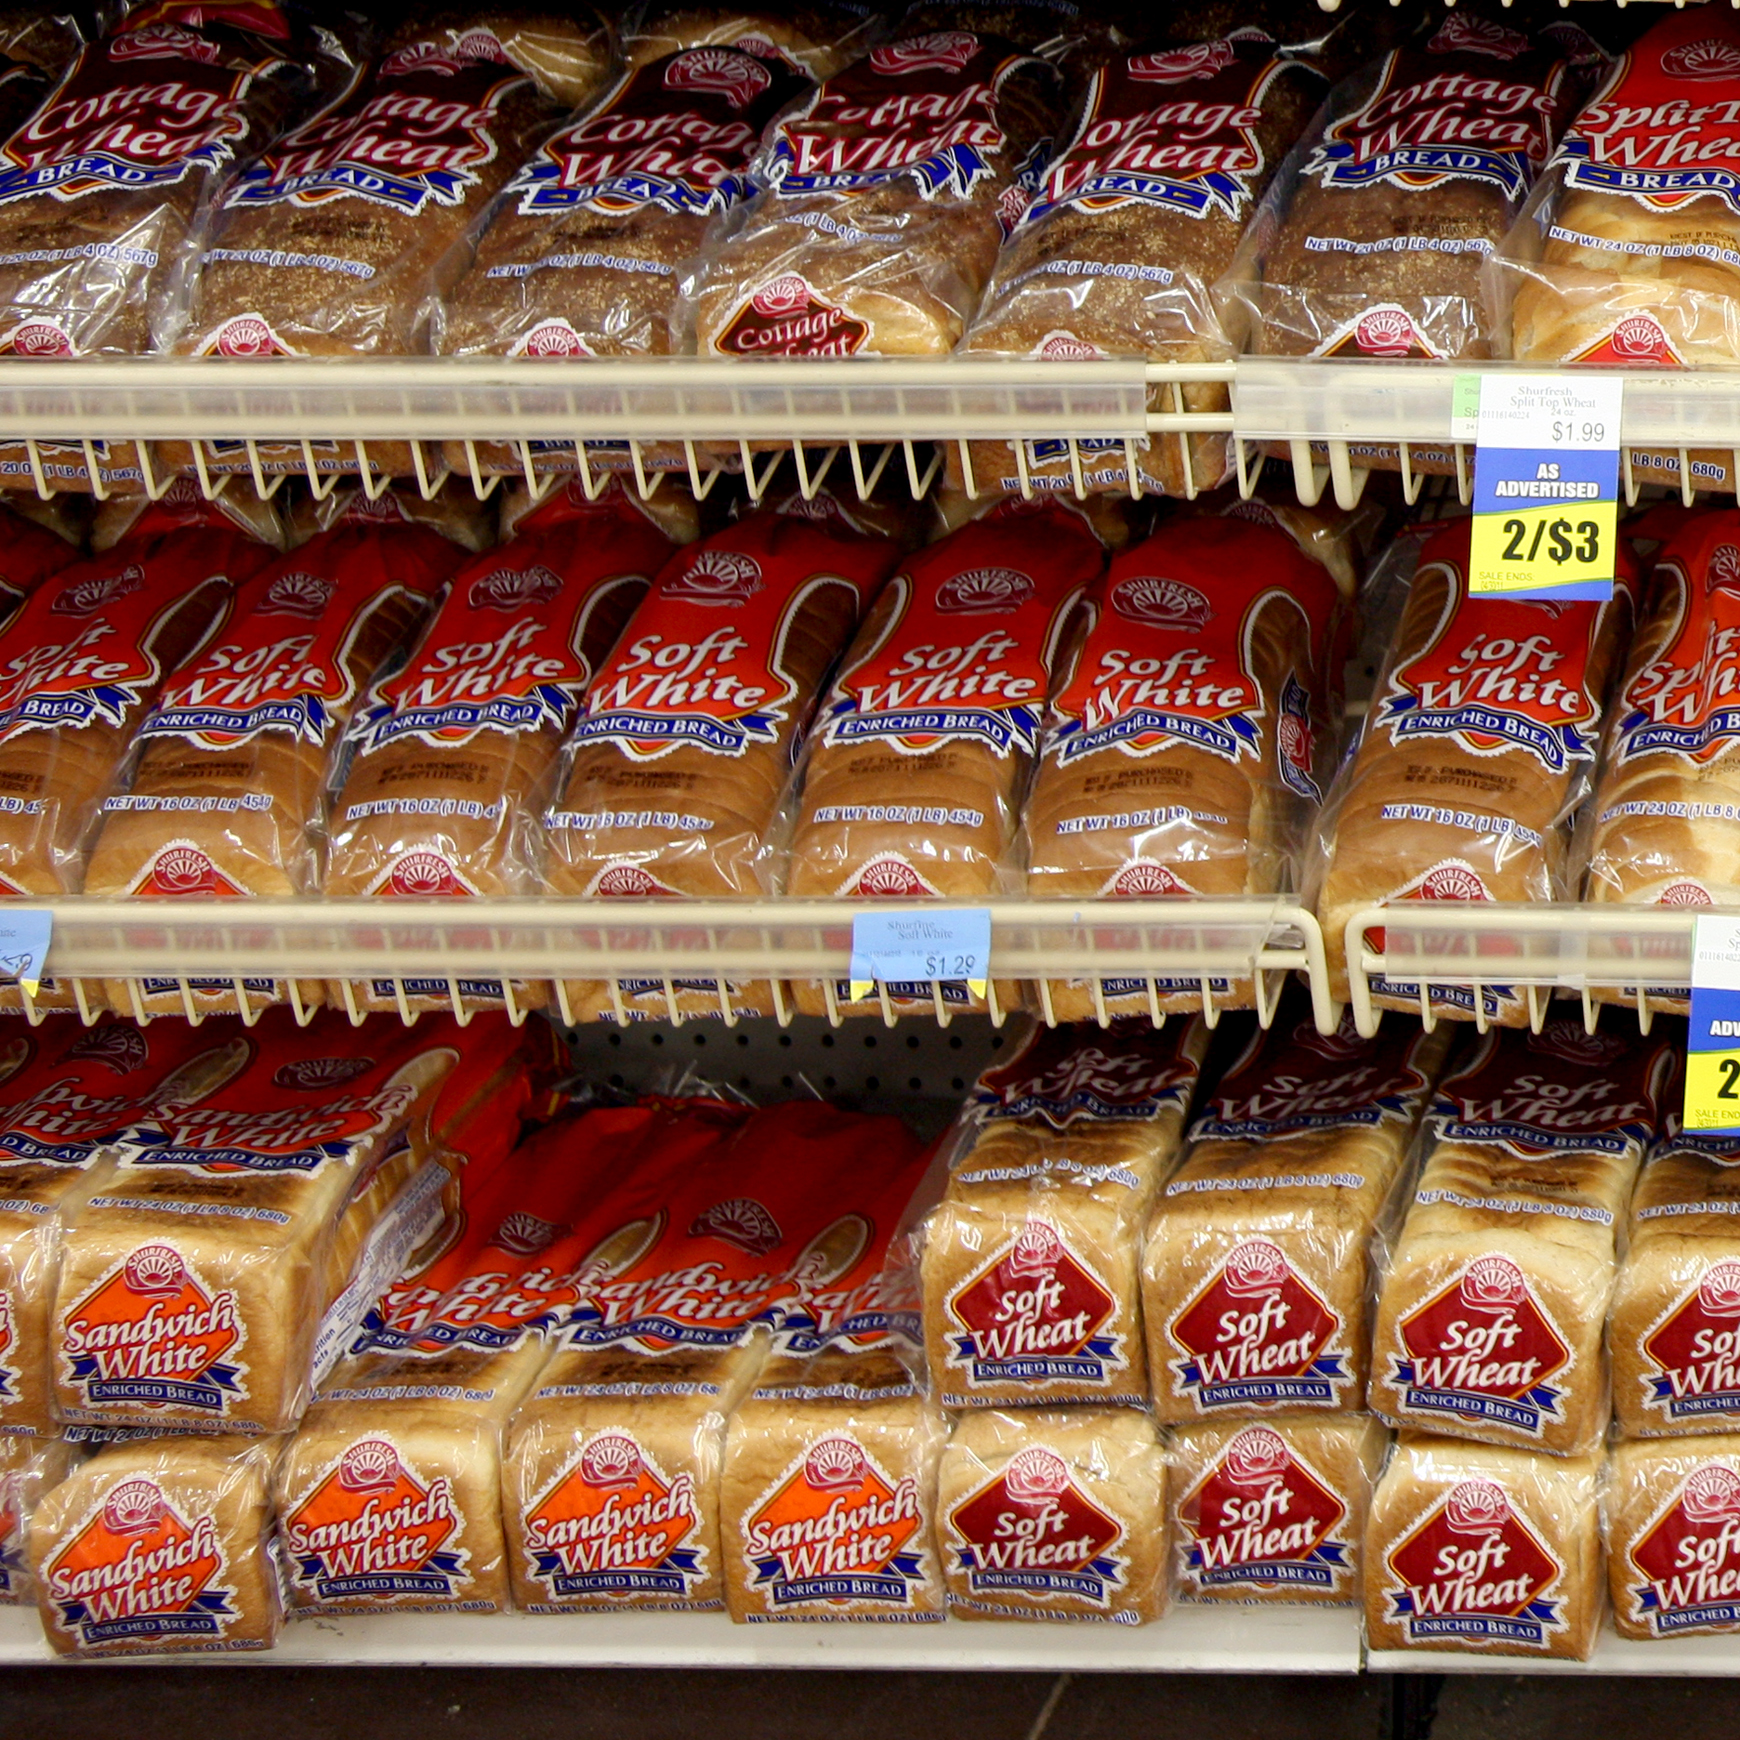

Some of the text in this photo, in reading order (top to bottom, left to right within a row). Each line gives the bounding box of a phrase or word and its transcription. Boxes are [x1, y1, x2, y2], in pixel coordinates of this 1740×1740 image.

[1359, 74, 1557, 128] Cottage
[1361, 102, 1545, 162] Wheat
[1377, 148, 1480, 170] BREAD
[1510, 396, 1596, 410] Split Top Wheat
[1518, 386, 1572, 396] Shurfresh
[1552, 421, 1605, 442] $1.99
[1495, 481, 1599, 499] ADVERTISED
[1536, 463, 1559, 480] AS
[1501, 518, 1599, 565] 2/$3
[617, 626, 748, 679] Soft
[585, 667, 766, 716] White
[926, 956, 975, 976] $1.29
[66, 1293, 231, 1353] Sandwich
[1440, 1313, 1522, 1361] Soft
[92, 1337, 206, 1379] White
[1410, 1350, 1540, 1388] Wheat
[1411, 1391, 1534, 1426] ENRICHED BREAD
